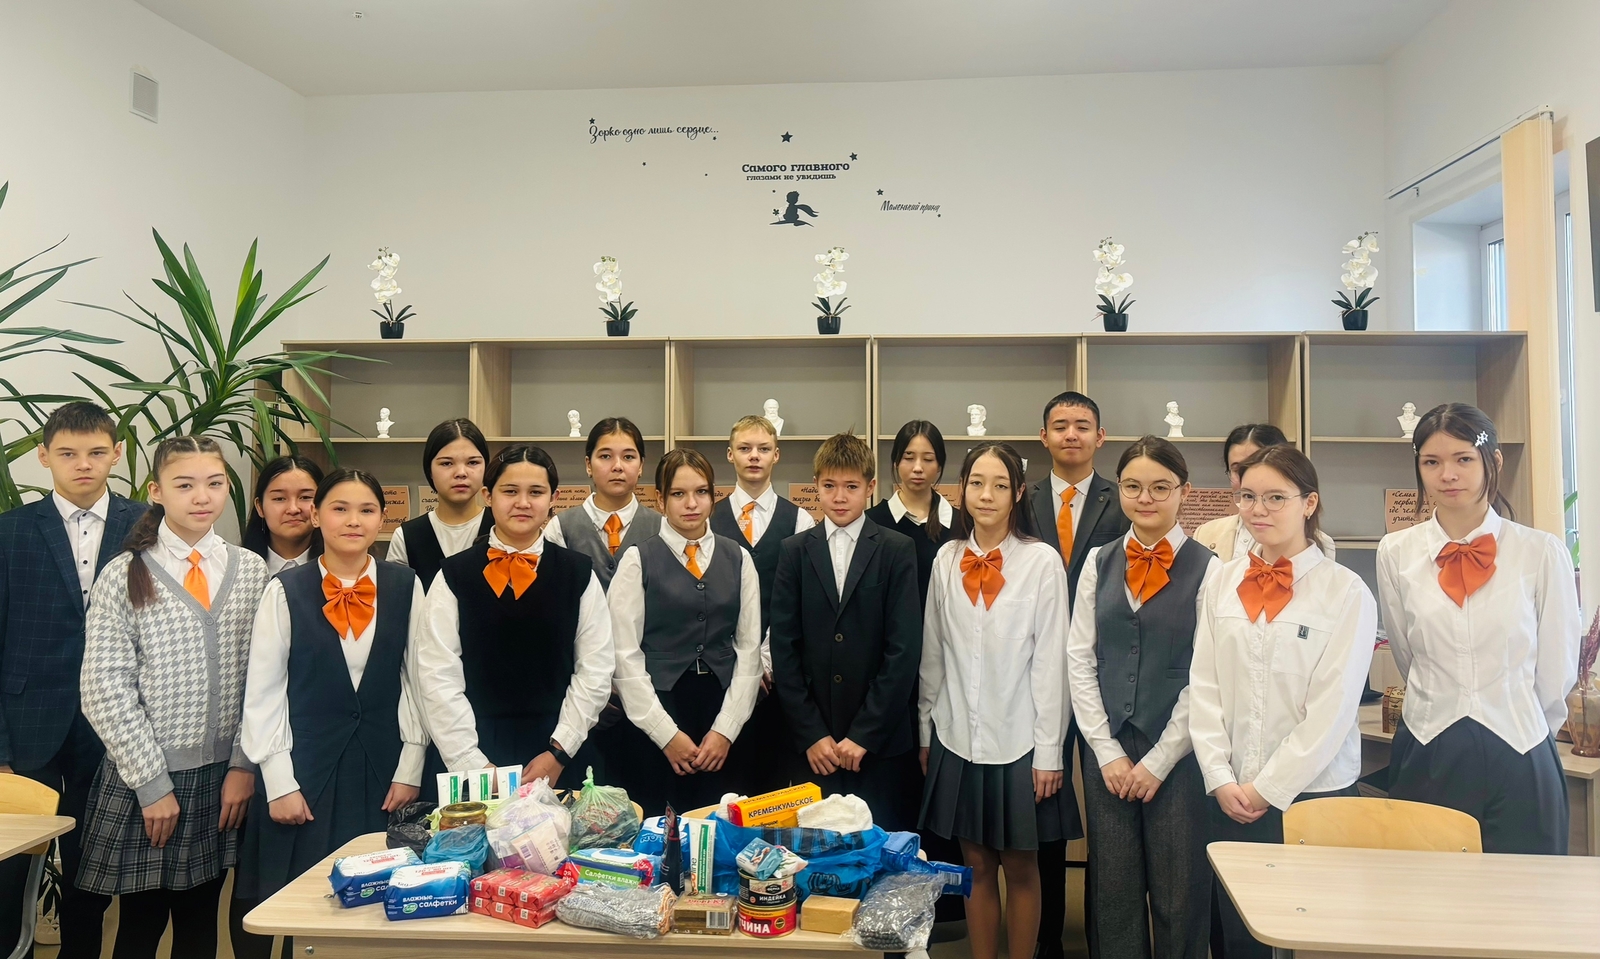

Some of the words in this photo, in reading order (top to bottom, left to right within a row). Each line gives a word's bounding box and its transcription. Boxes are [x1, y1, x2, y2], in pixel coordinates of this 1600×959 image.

[589, 125, 621, 144] Зорко
[622, 127, 646, 142] одно
[648, 127, 674, 135] лишь
[742, 164, 787, 173] Самого
[790, 163, 850, 172] главного
[796, 173, 837, 181] увидишь
[748, 796, 814, 818] КРЕМЕНКУЛЬСКОЕ
[585, 869, 617, 880] Салфетки
[419, 900, 457, 909] салфетки
[740, 919, 771, 934] ЧИНА
